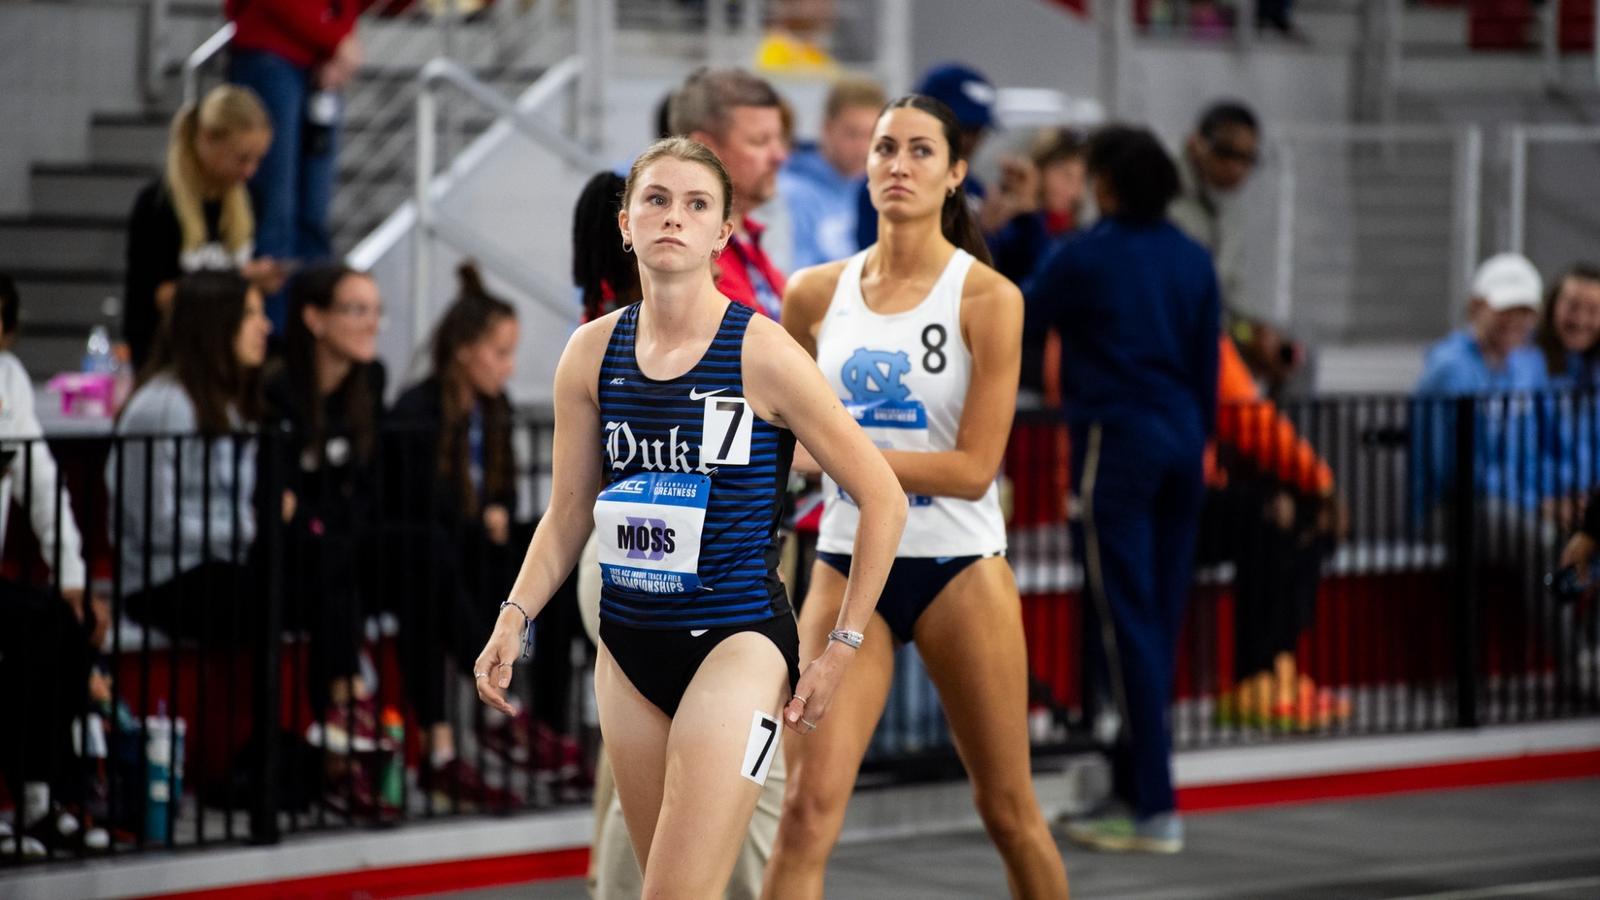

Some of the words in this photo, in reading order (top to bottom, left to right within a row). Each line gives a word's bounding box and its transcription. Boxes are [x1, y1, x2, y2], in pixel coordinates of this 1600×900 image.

[921, 323, 947, 374] 8
[716, 401, 744, 460] 7
[610, 480, 648, 492] ACC
[654, 487, 697, 498] GREATNESS
[617, 525, 675, 554] MOSS
[611, 575, 684, 592] CHAMPIONSHIPS
[647, 572, 662, 581] TRACK
[750, 717, 778, 778] 7
